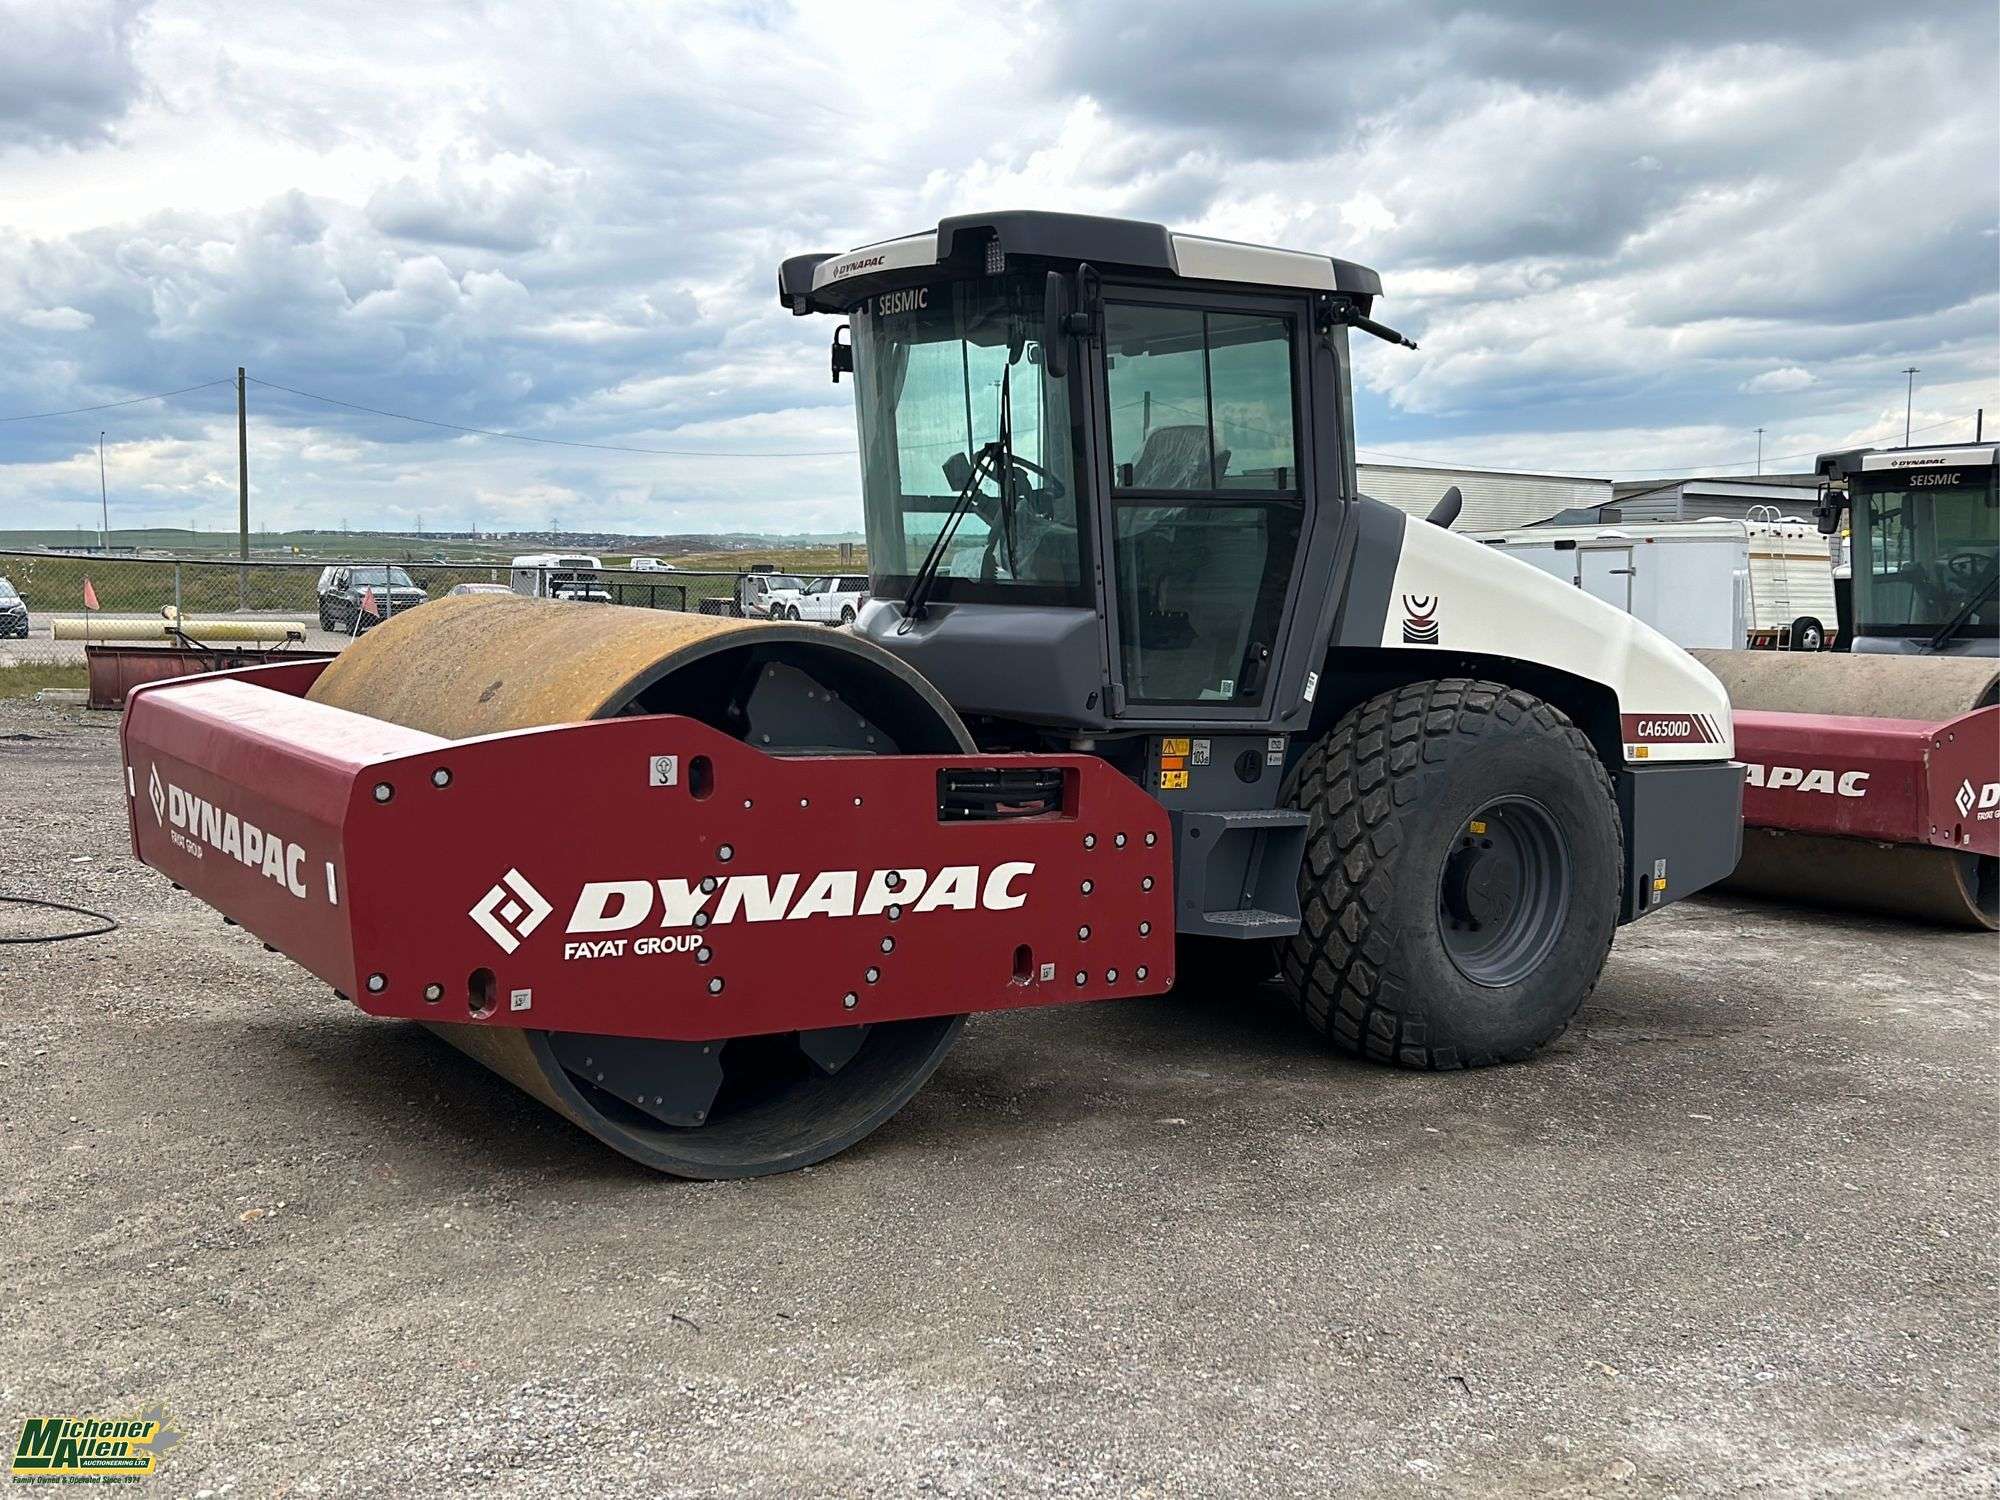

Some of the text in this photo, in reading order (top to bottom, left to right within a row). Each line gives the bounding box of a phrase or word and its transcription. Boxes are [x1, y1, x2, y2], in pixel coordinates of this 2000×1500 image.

[839, 255, 886, 275] DYNAPAC
[879, 287, 929, 317] SEISMIC
[1899, 458, 1946, 466] DYNAPAC
[1910, 473, 1961, 487] SEISMIC
[1637, 720, 1691, 737] CA6500D
[1744, 763, 1870, 798] APAC
[168, 783, 306, 899] DYNAPAC
[564, 861, 1036, 934] DYNAPAC
[564, 934, 703, 960] FAYAT GROUP
